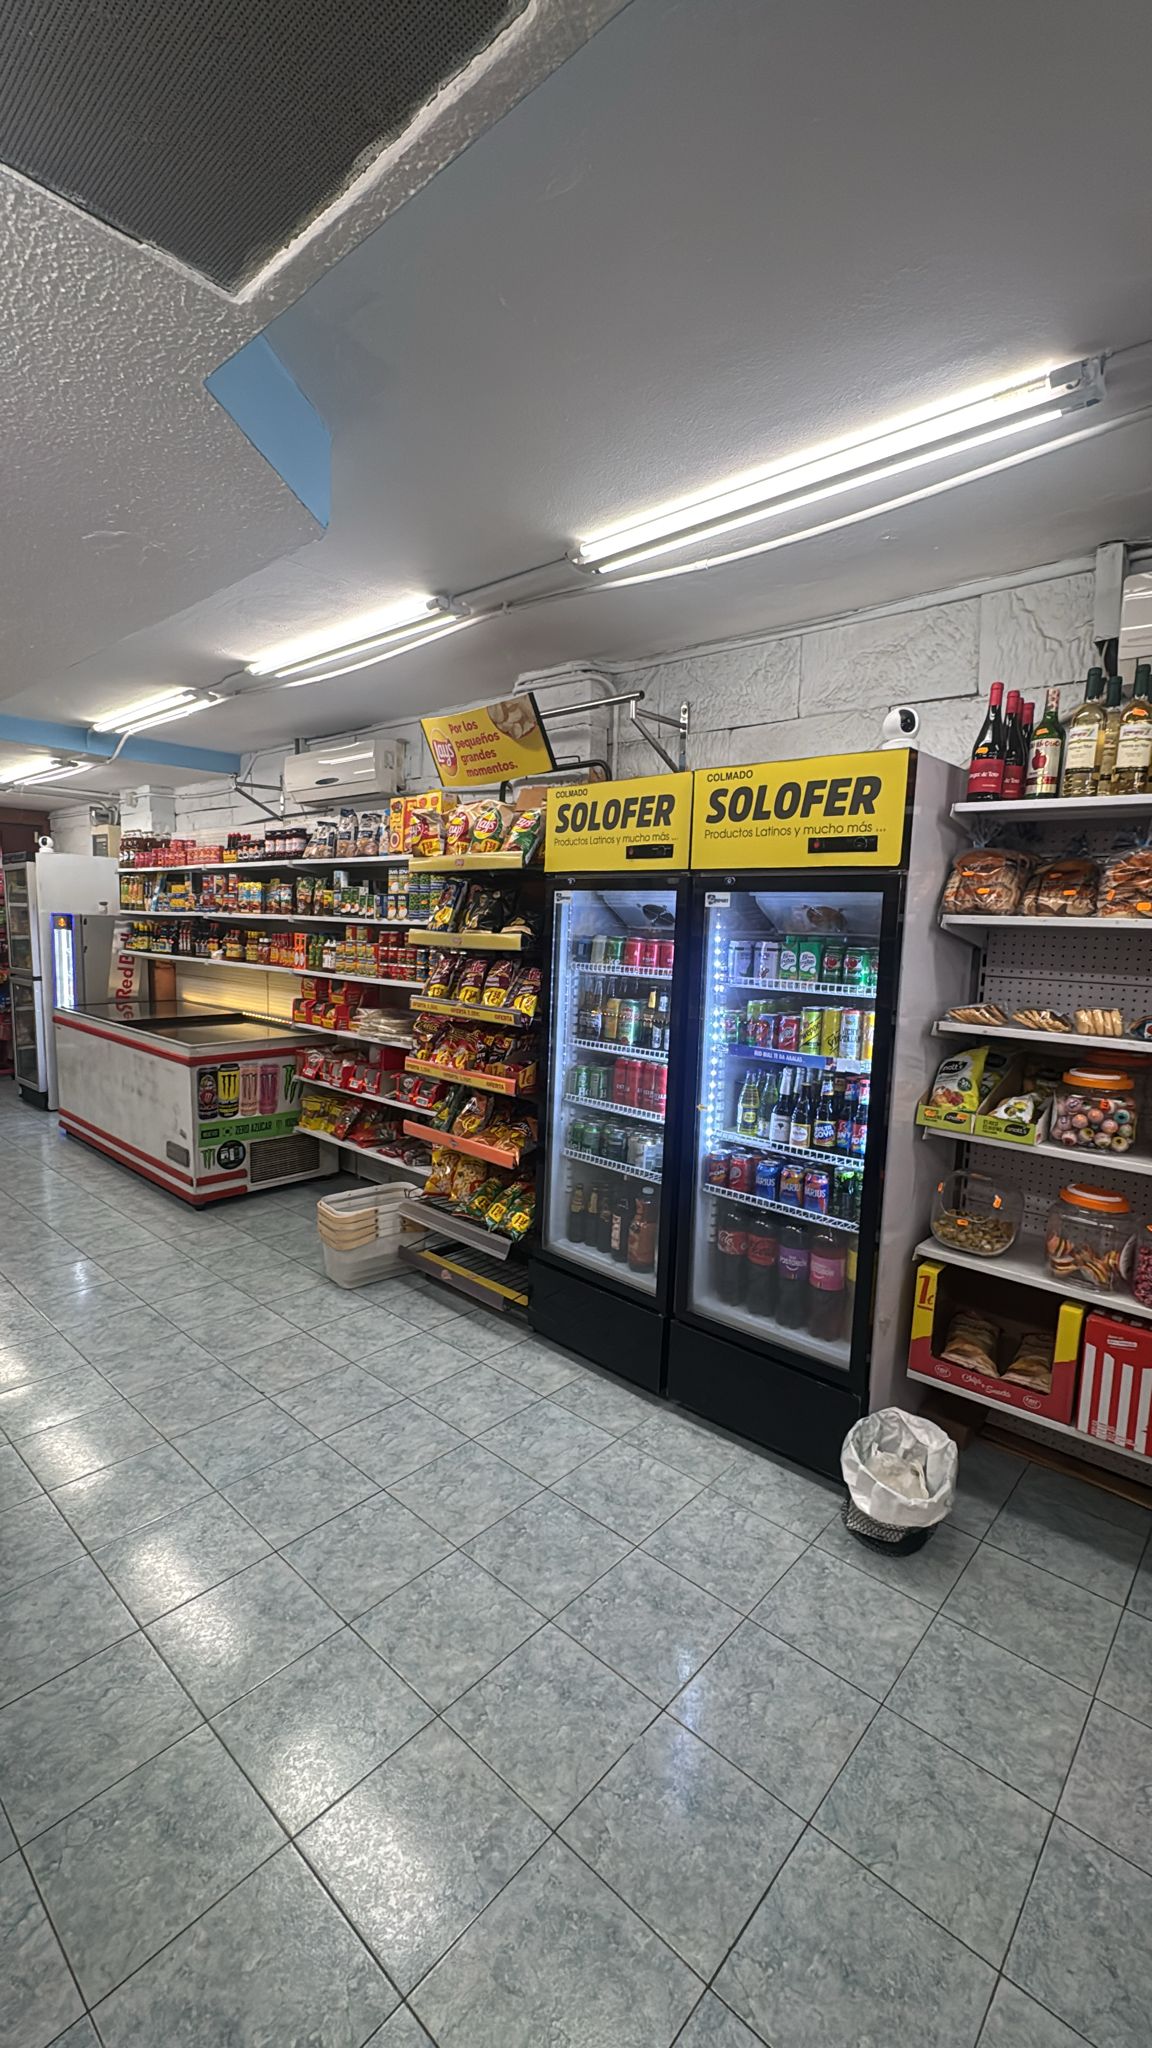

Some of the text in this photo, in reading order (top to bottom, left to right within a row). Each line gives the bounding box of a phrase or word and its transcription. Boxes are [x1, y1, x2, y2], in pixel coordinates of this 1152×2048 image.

[448, 720, 478, 735] Por los
[455, 730, 500, 750] pequeños
[460, 748, 497, 766] grandes
[466, 760, 518, 777] momentos.
[706, 769, 753, 783] COLMADO
[555, 788, 588, 799] COLMADO
[705, 776, 882, 825] SOLOFER
[554, 794, 676, 834] SOLOFER
[704, 827, 753, 840] Productos
[755, 825, 791, 837] Latinos
[793, 828, 801, 838] y
[803, 823, 845, 835] mucho
[846, 821, 873, 834] más
[554, 835, 588, 847] Productos
[589, 834, 614, 845] Latinos
[615, 836, 621, 846] y
[622, 833, 651, 844] mucho
[652, 832, 670, 842] más
[115, 966, 134, 999] Red
[450, 1007, 466, 1015] OFERTA
[494, 1013, 512, 1022] OFERTA
[486, 1081, 505, 1090] OFERTA
